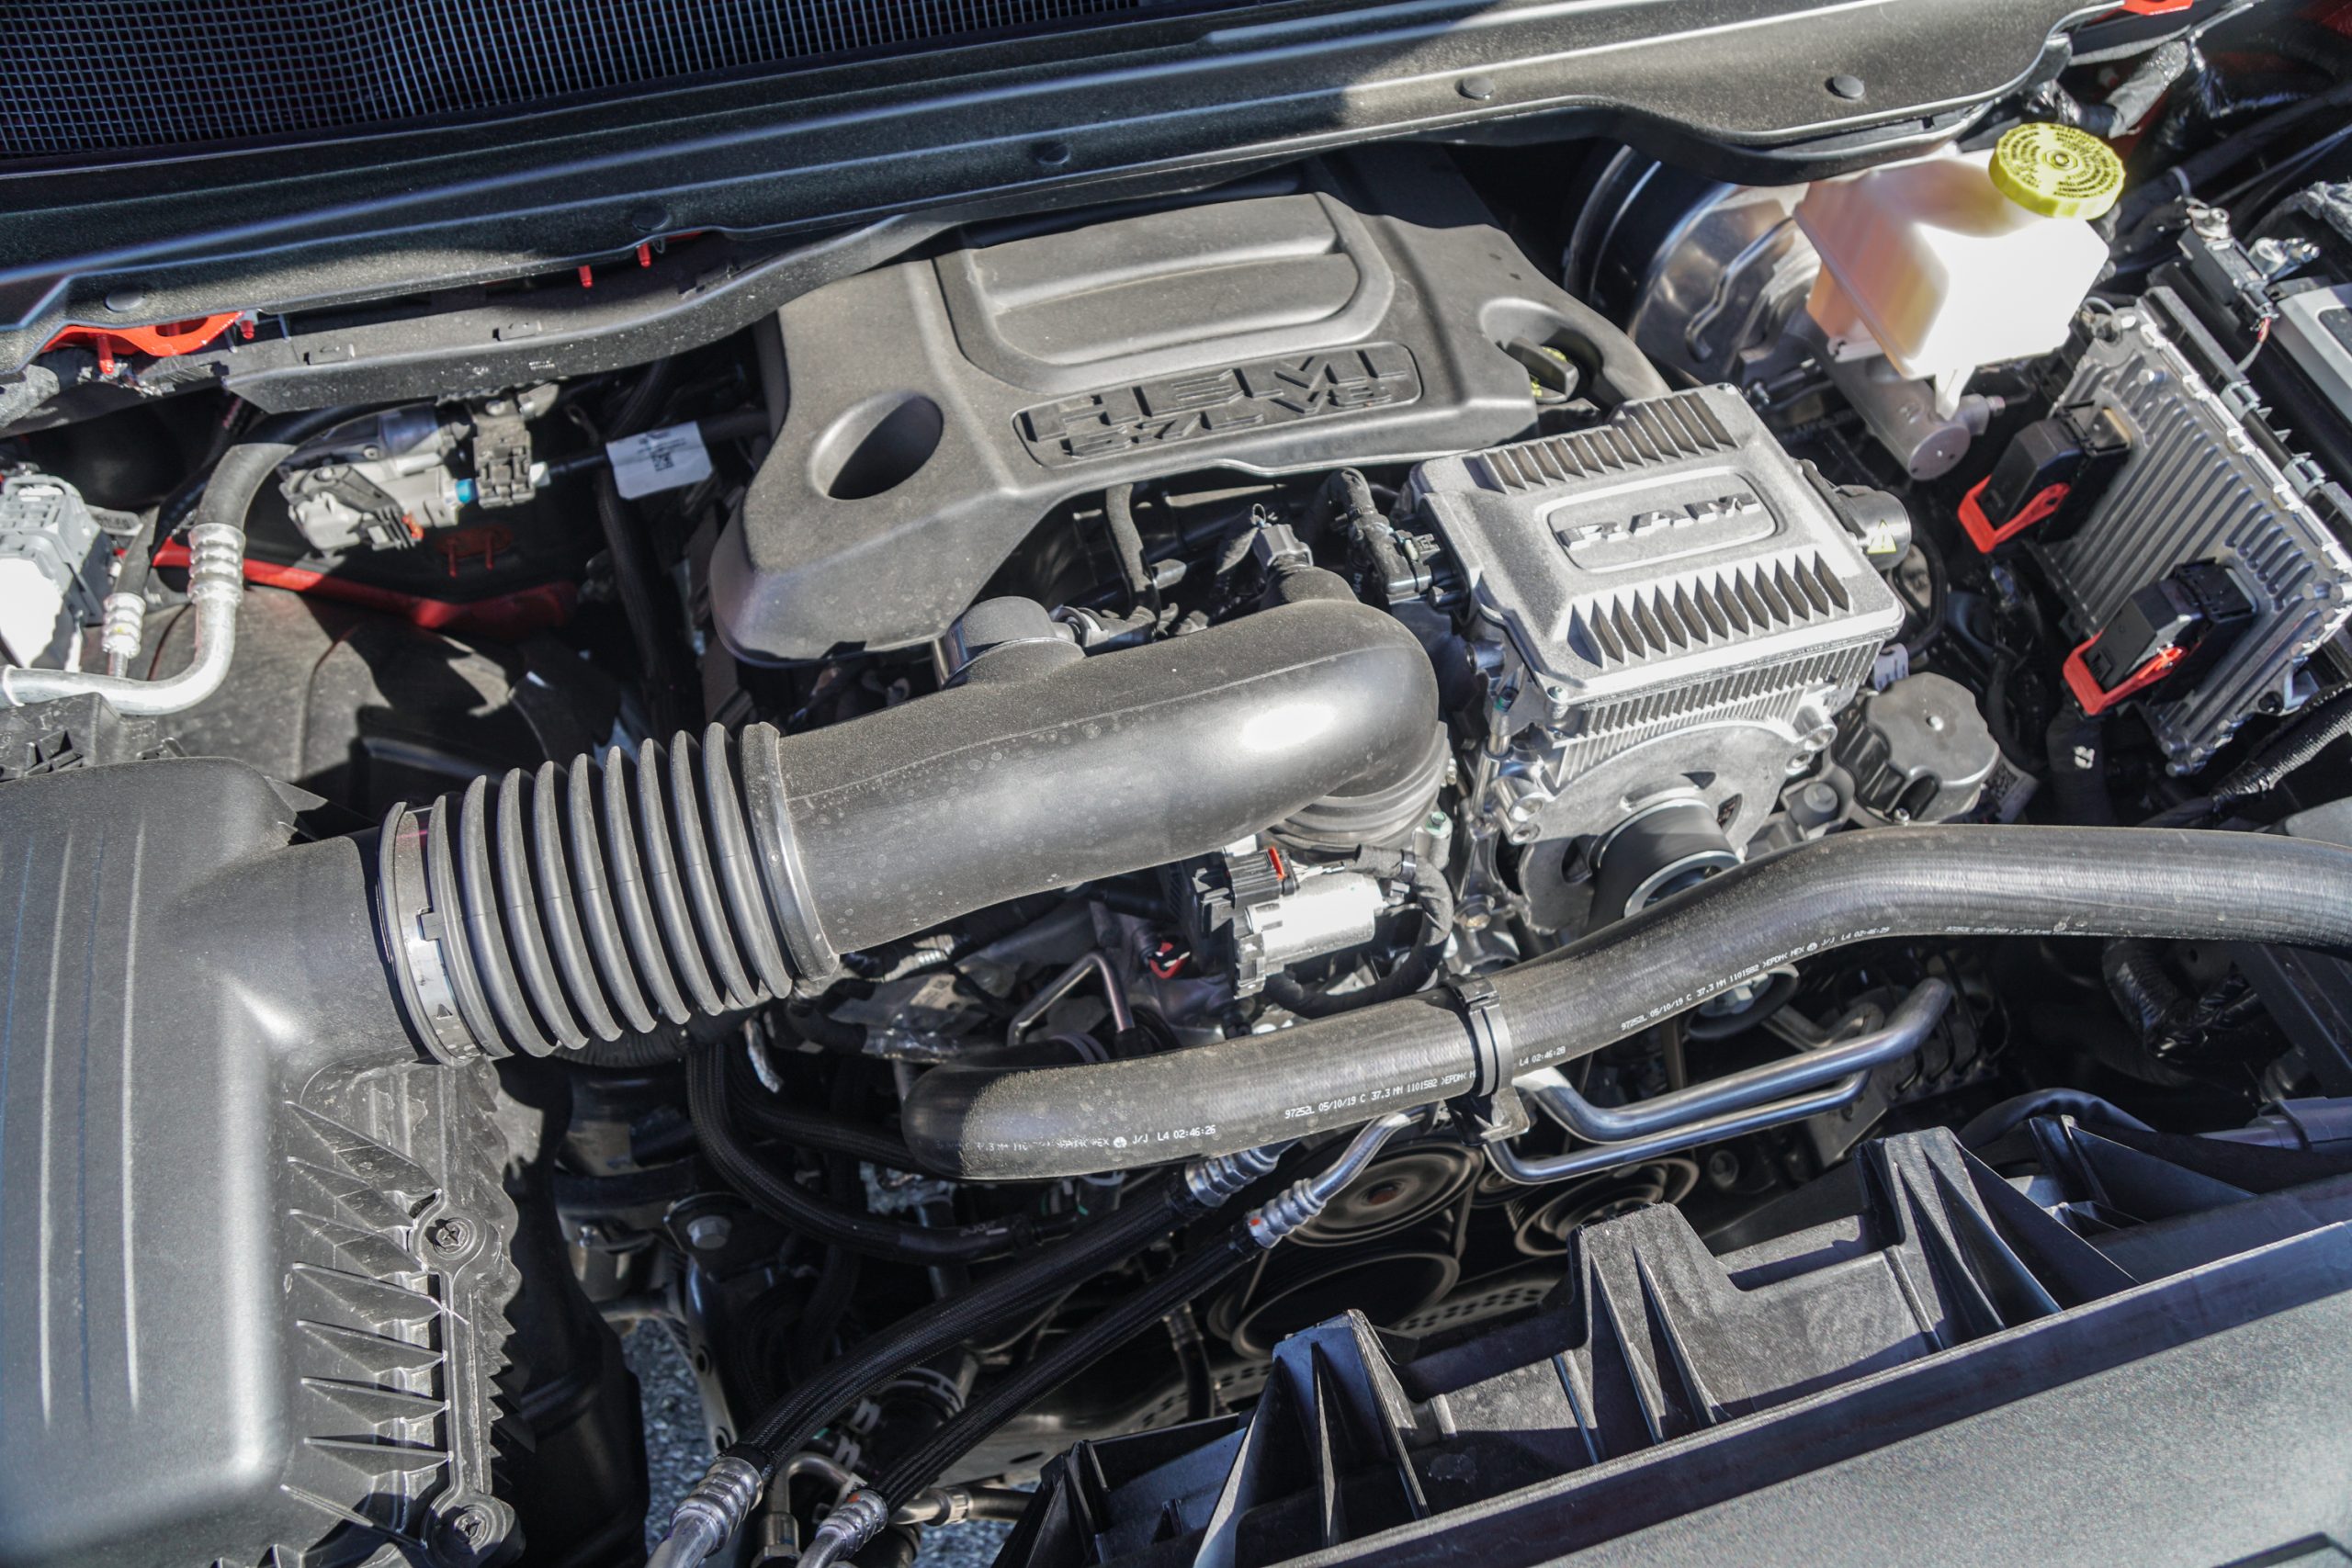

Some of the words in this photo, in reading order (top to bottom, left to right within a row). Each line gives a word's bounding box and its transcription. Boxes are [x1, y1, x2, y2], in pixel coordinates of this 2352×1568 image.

[1019, 349, 1407, 443] HEMI
[1059, 411, 1264, 458] 5.7L
[1269, 383, 1392, 414] V8
[1555, 491, 1761, 550] RAM
[1519, 1056, 1529, 1066] L4
[1318, 1096, 1356, 1111] 05/10/19
[1360, 1093, 1366, 1103] C
[1371, 1088, 1391, 1100] 37.3
[1407, 1078, 1438, 1093] 1101582
[1132, 1134, 1148, 1145] J/J
[1157, 1131, 1170, 1142] L4
[1173, 1124, 1216, 1139] 02:46:26
